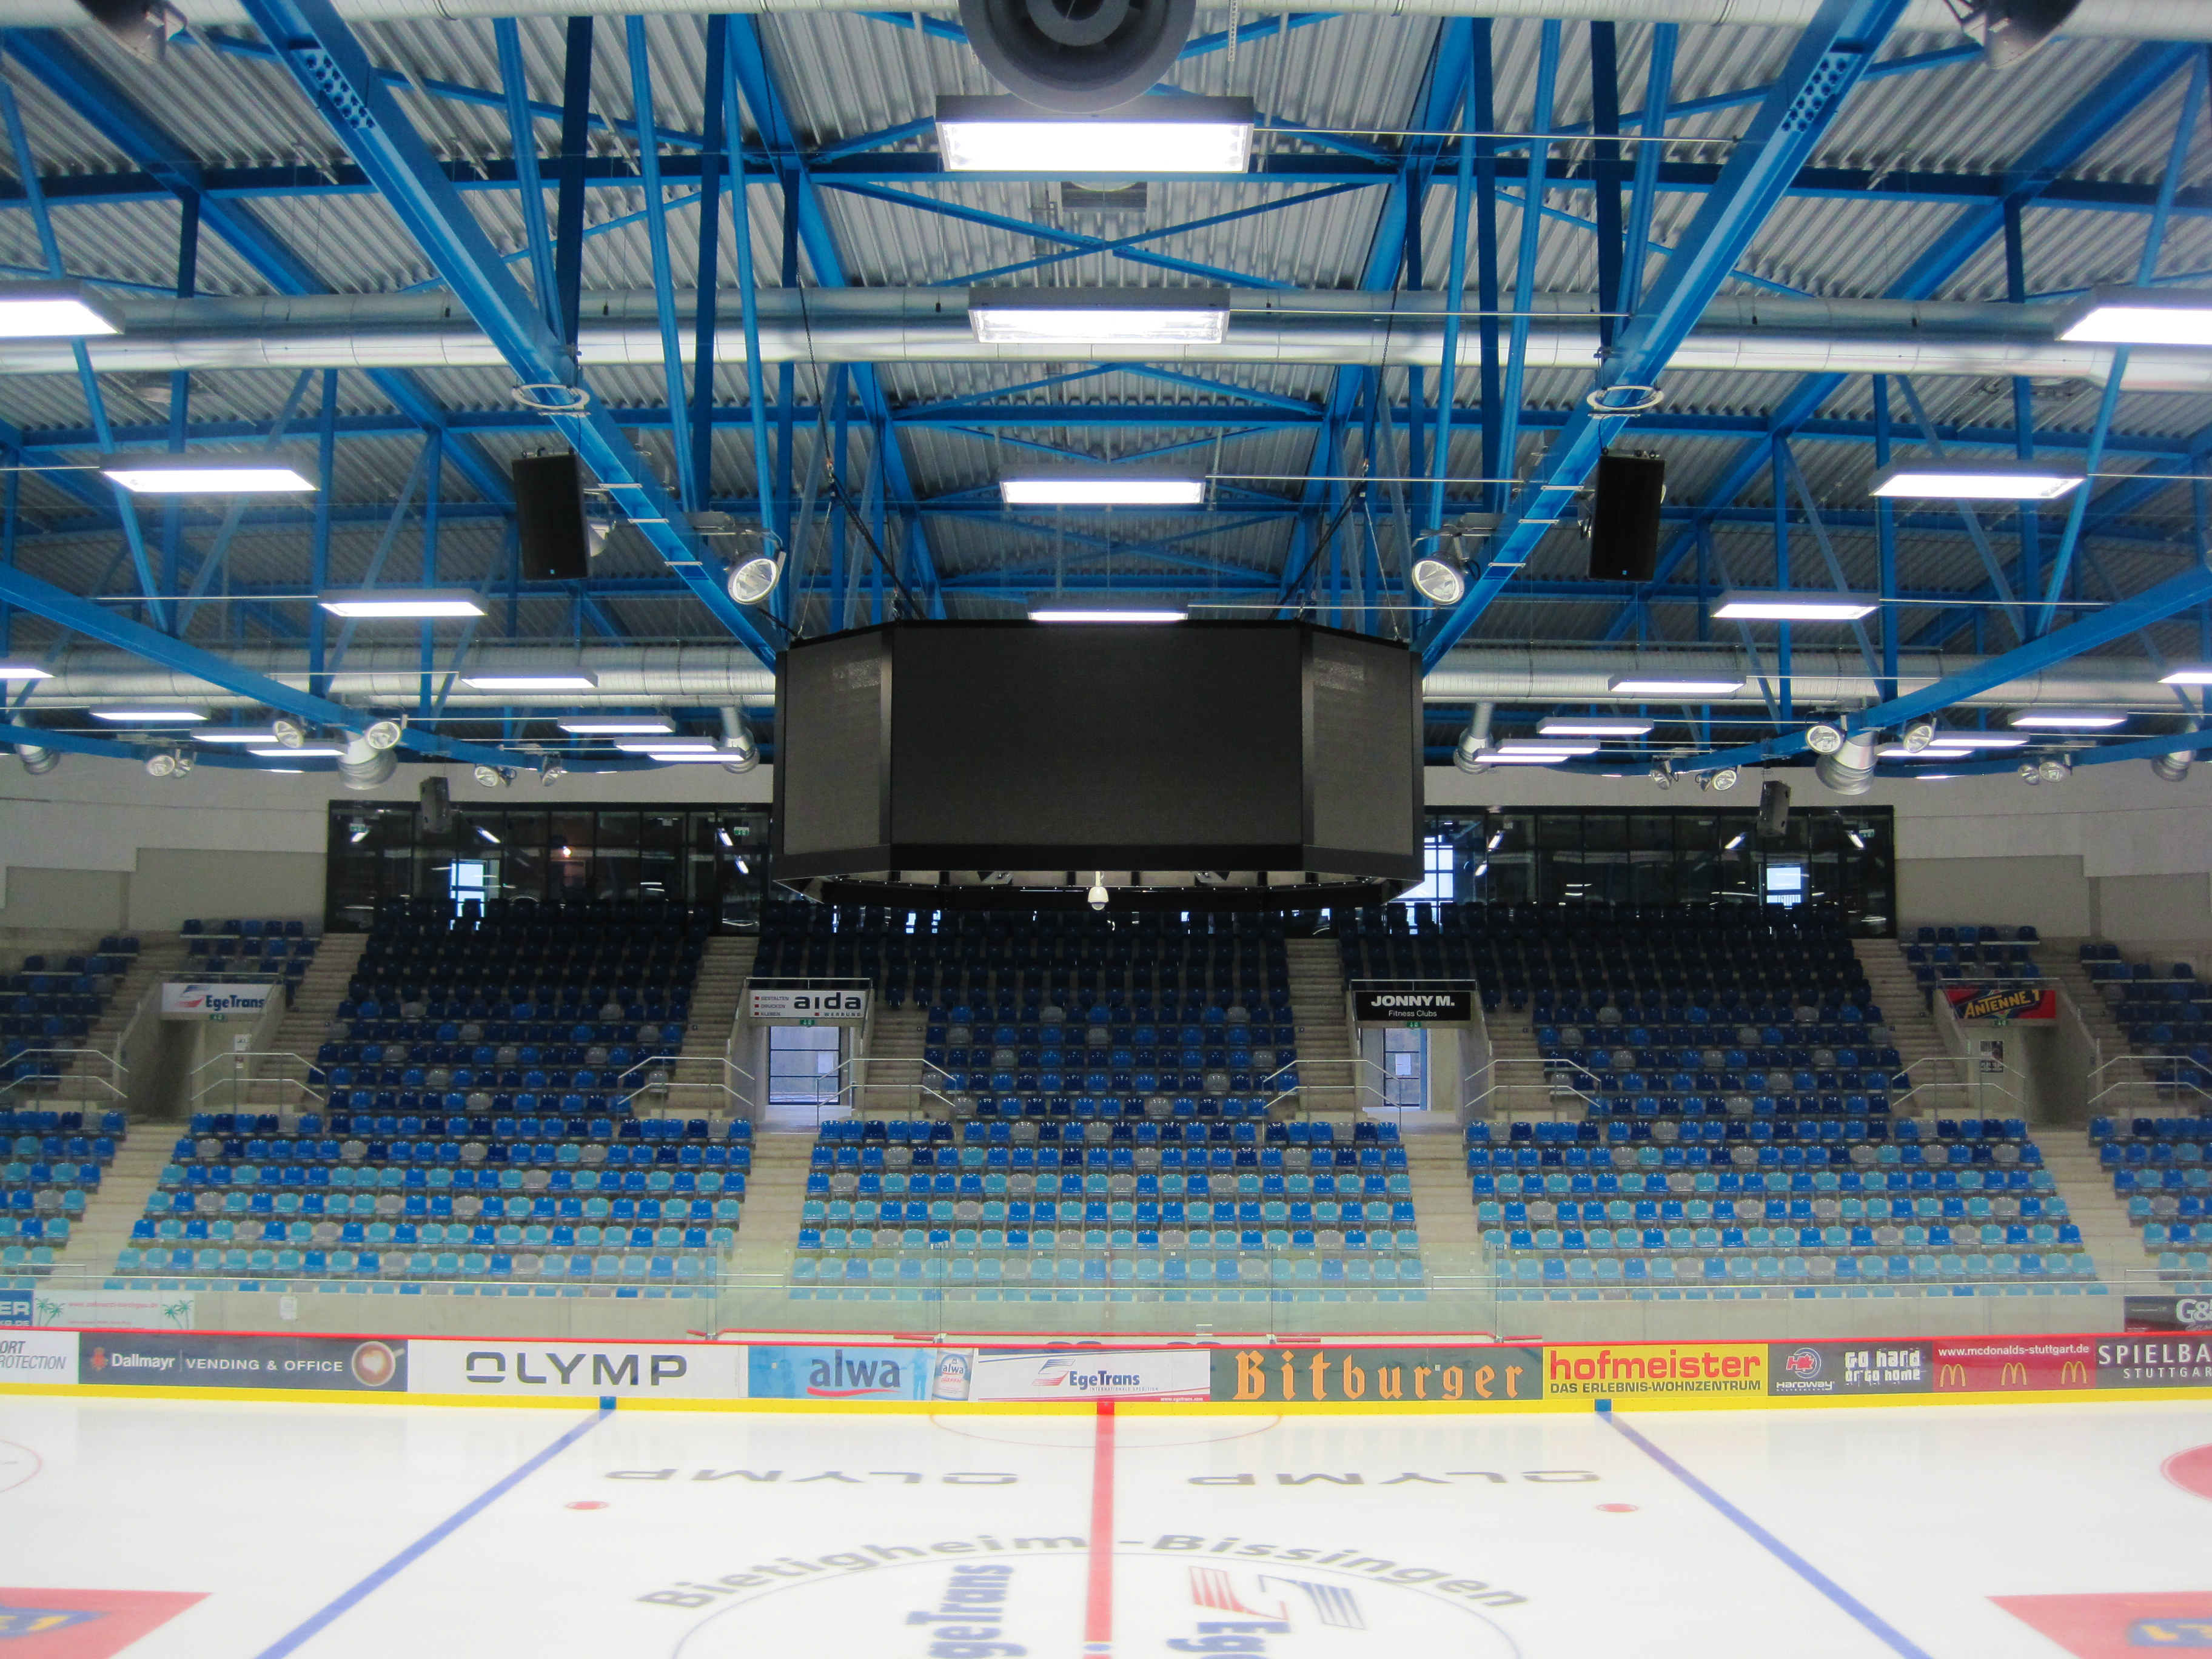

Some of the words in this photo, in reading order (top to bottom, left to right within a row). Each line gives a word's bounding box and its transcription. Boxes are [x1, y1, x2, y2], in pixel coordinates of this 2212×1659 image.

[205, 994, 265, 1011] EgeTrans
[794, 992, 861, 1009] aida
[1371, 995, 1433, 1007] JONNY
[1435, 996, 1455, 1007] M.
[1963, 991, 2031, 1019] ANTENNE
[2032, 989, 2040, 1001] 1
[1939, 1343, 2090, 1356] www.mcdonalds-stuttgart.de
[2098, 1342, 2212, 1364] SPIELBA
[112, 1353, 176, 1370] Dallmayr
[186, 1358, 260, 1370] VENDING
[267, 1360, 278, 1370] &
[284, 1360, 343, 1372] OFFICE
[465, 1351, 688, 1386] OLYMP
[809, 1349, 900, 1387] alwa
[942, 1364, 964, 1374] alwa
[1550, 1349, 1761, 1379] hofmeister
[1069, 1370, 1140, 1390] EgeTrans
[1232, 1350, 1524, 1401] Bitburger
[1550, 1383, 1577, 1393] DAS
[1583, 1380, 1761, 1393] ERLEBNIS-WOHNZENTRUM
[605, 1469, 1019, 1484] OLYMP
[1188, 1470, 1601, 1485] OLYMP
